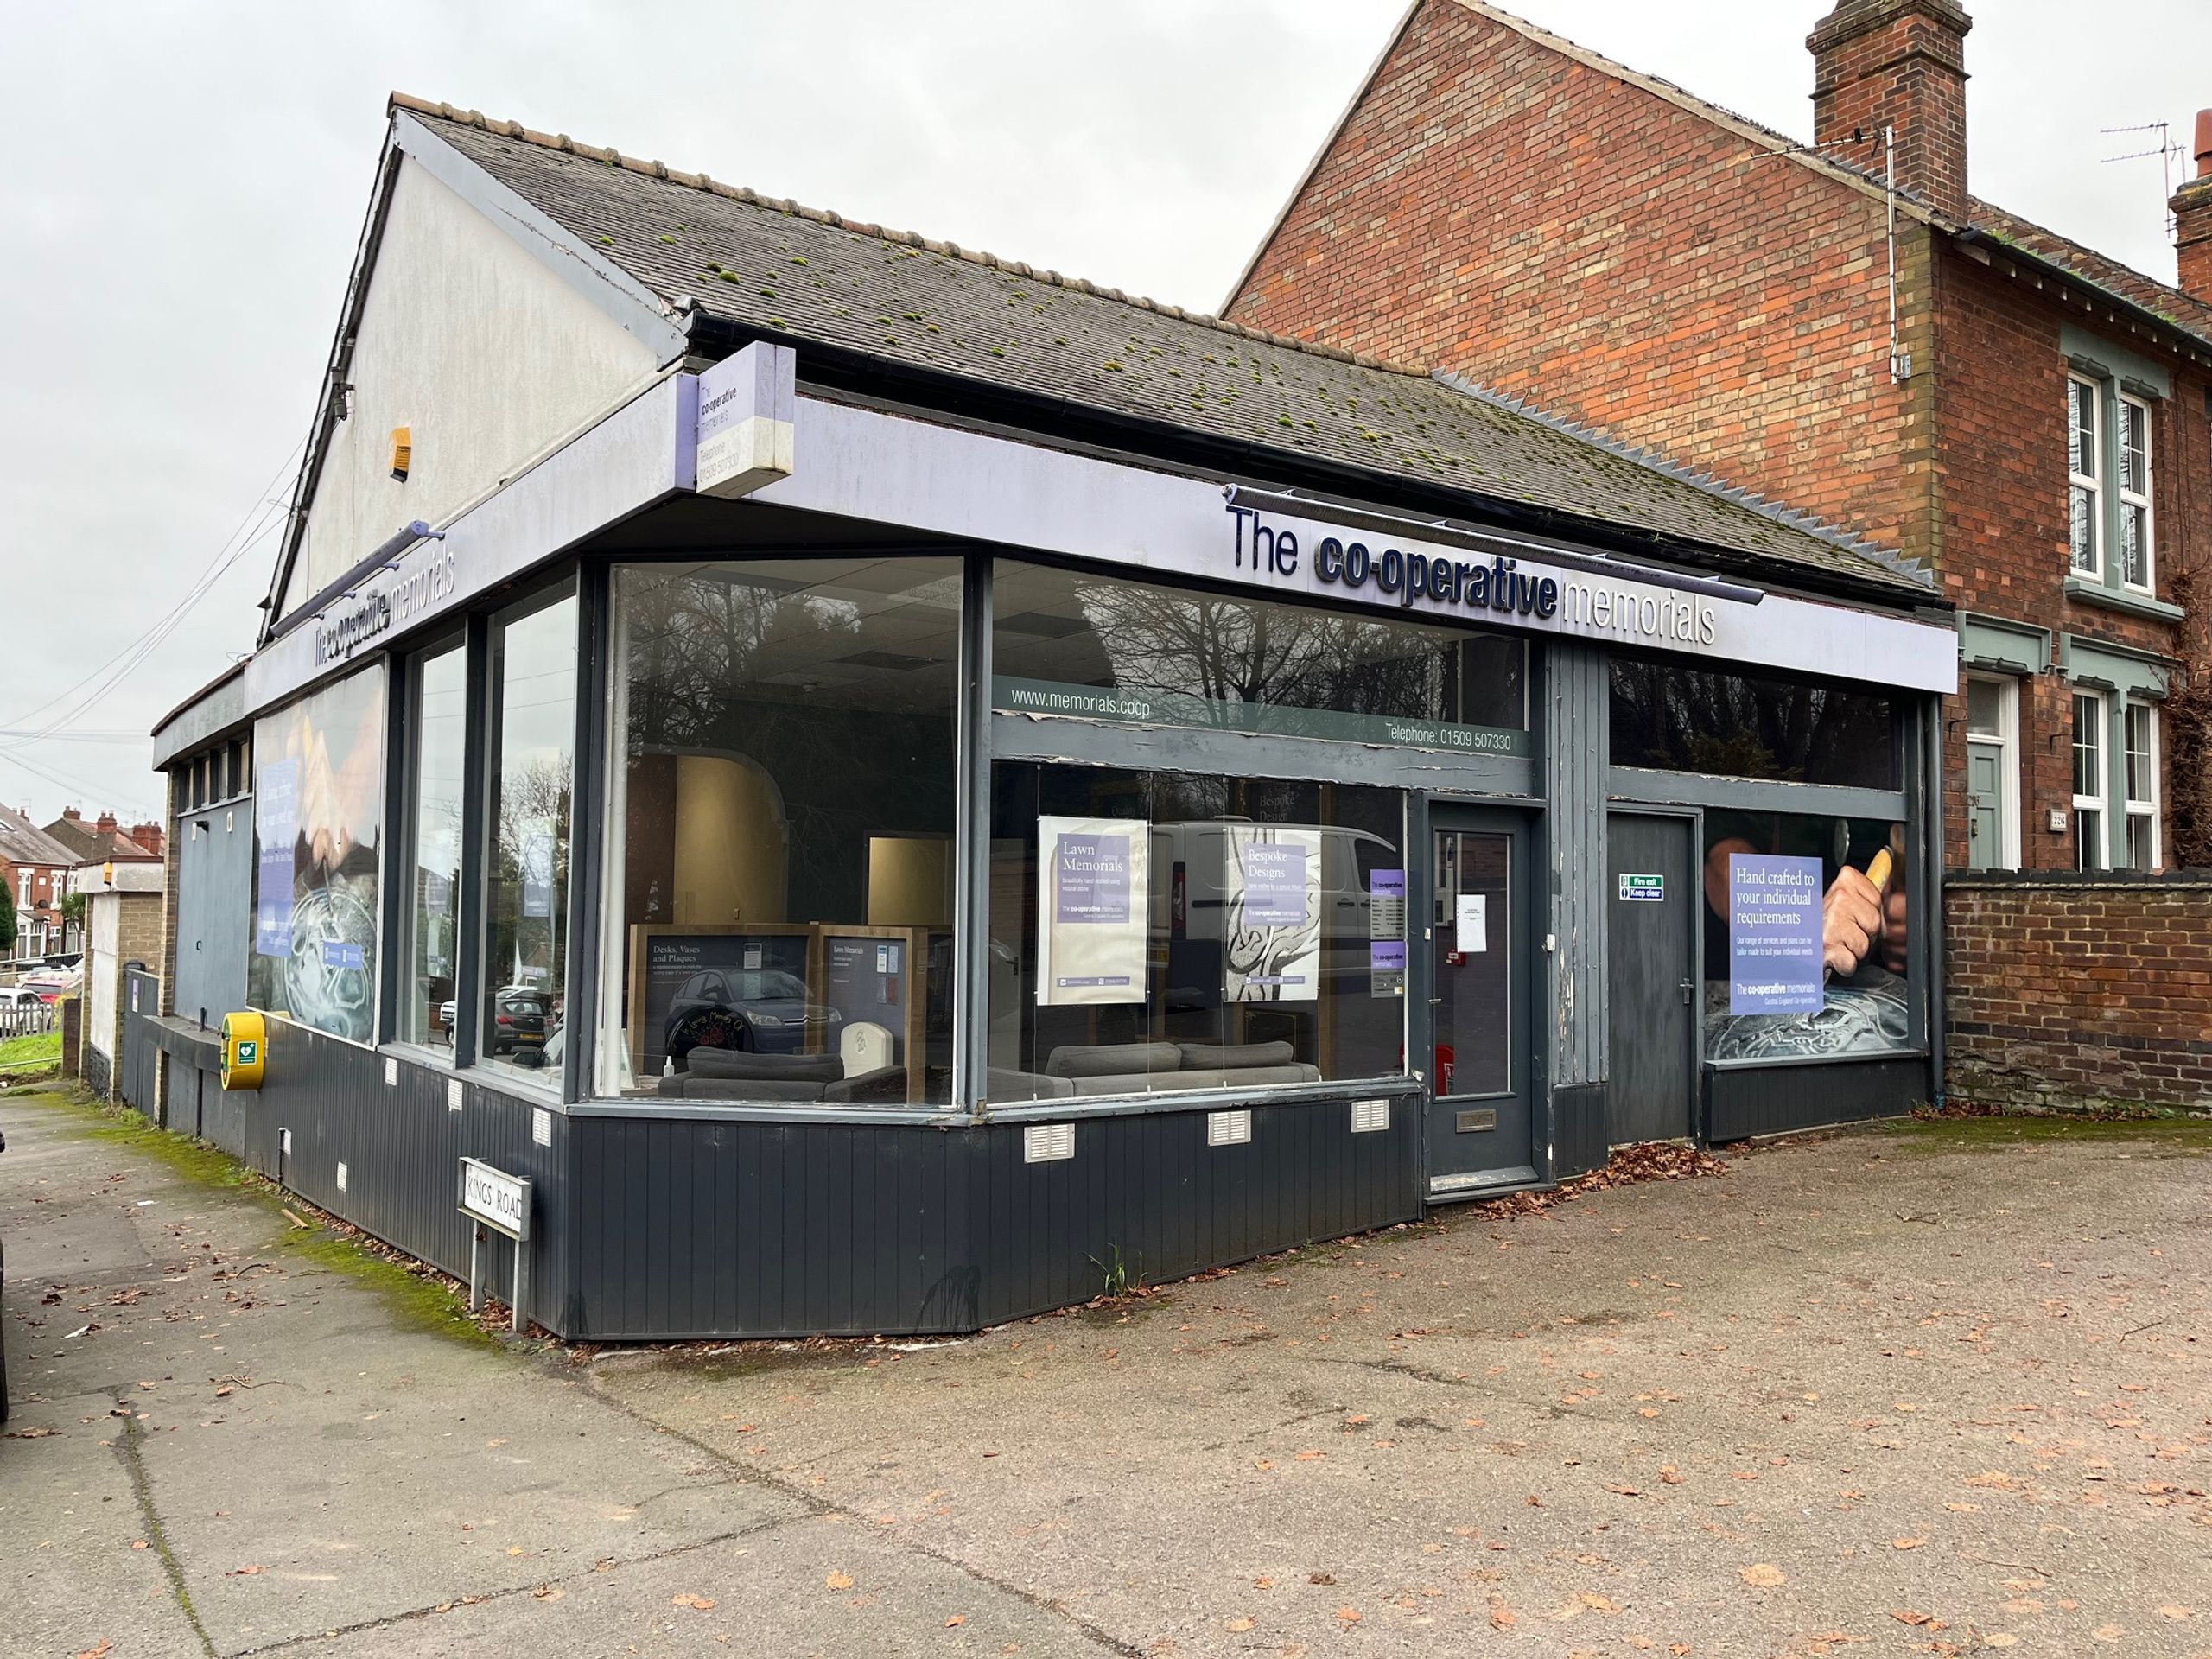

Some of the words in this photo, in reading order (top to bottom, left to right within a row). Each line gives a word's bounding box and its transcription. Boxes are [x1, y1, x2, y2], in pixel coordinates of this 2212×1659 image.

[702, 387, 737, 416] co-operative
[1225, 505, 1300, 576] The
[1314, 537, 1559, 619] co-operative
[1562, 579, 1716, 646] memorials
[391, 543, 454, 626] memorials
[1011, 688, 1151, 719] www.memorials.coop
[1385, 722, 1439, 745] Telephone:
[1440, 729, 1472, 747] 01509
[1474, 732, 1512, 751] 507330
[1063, 842, 1095, 855] Lawn
[1249, 849, 1287, 863] Bespoke
[1063, 858, 1123, 872] Memorials
[1249, 865, 1286, 880] Designs
[1736, 868, 1765, 884] Hand
[1768, 869, 1802, 885] crafted
[1804, 874, 1815, 887] to
[1633, 877, 1645, 886] Fire
[1646, 877, 1657, 886] exit
[1630, 888, 1645, 899] Keep
[1646, 888, 1661, 898] clear
[1736, 893, 1760, 906] your
[1763, 889, 1812, 905] individual
[1071, 905, 1101, 913] co-operative
[1736, 909, 1801, 928] requirements
[652, 945, 677, 954] Desks,
[679, 945, 701, 954] Vases
[668, 955, 696, 963] Plaques
[1737, 982, 1747, 995] The
[1747, 982, 1786, 996] co-operative
[1787, 982, 1815, 994] memorials
[467, 1175, 491, 1206] KINGS
[497, 1190, 521, 1220] ROAD
